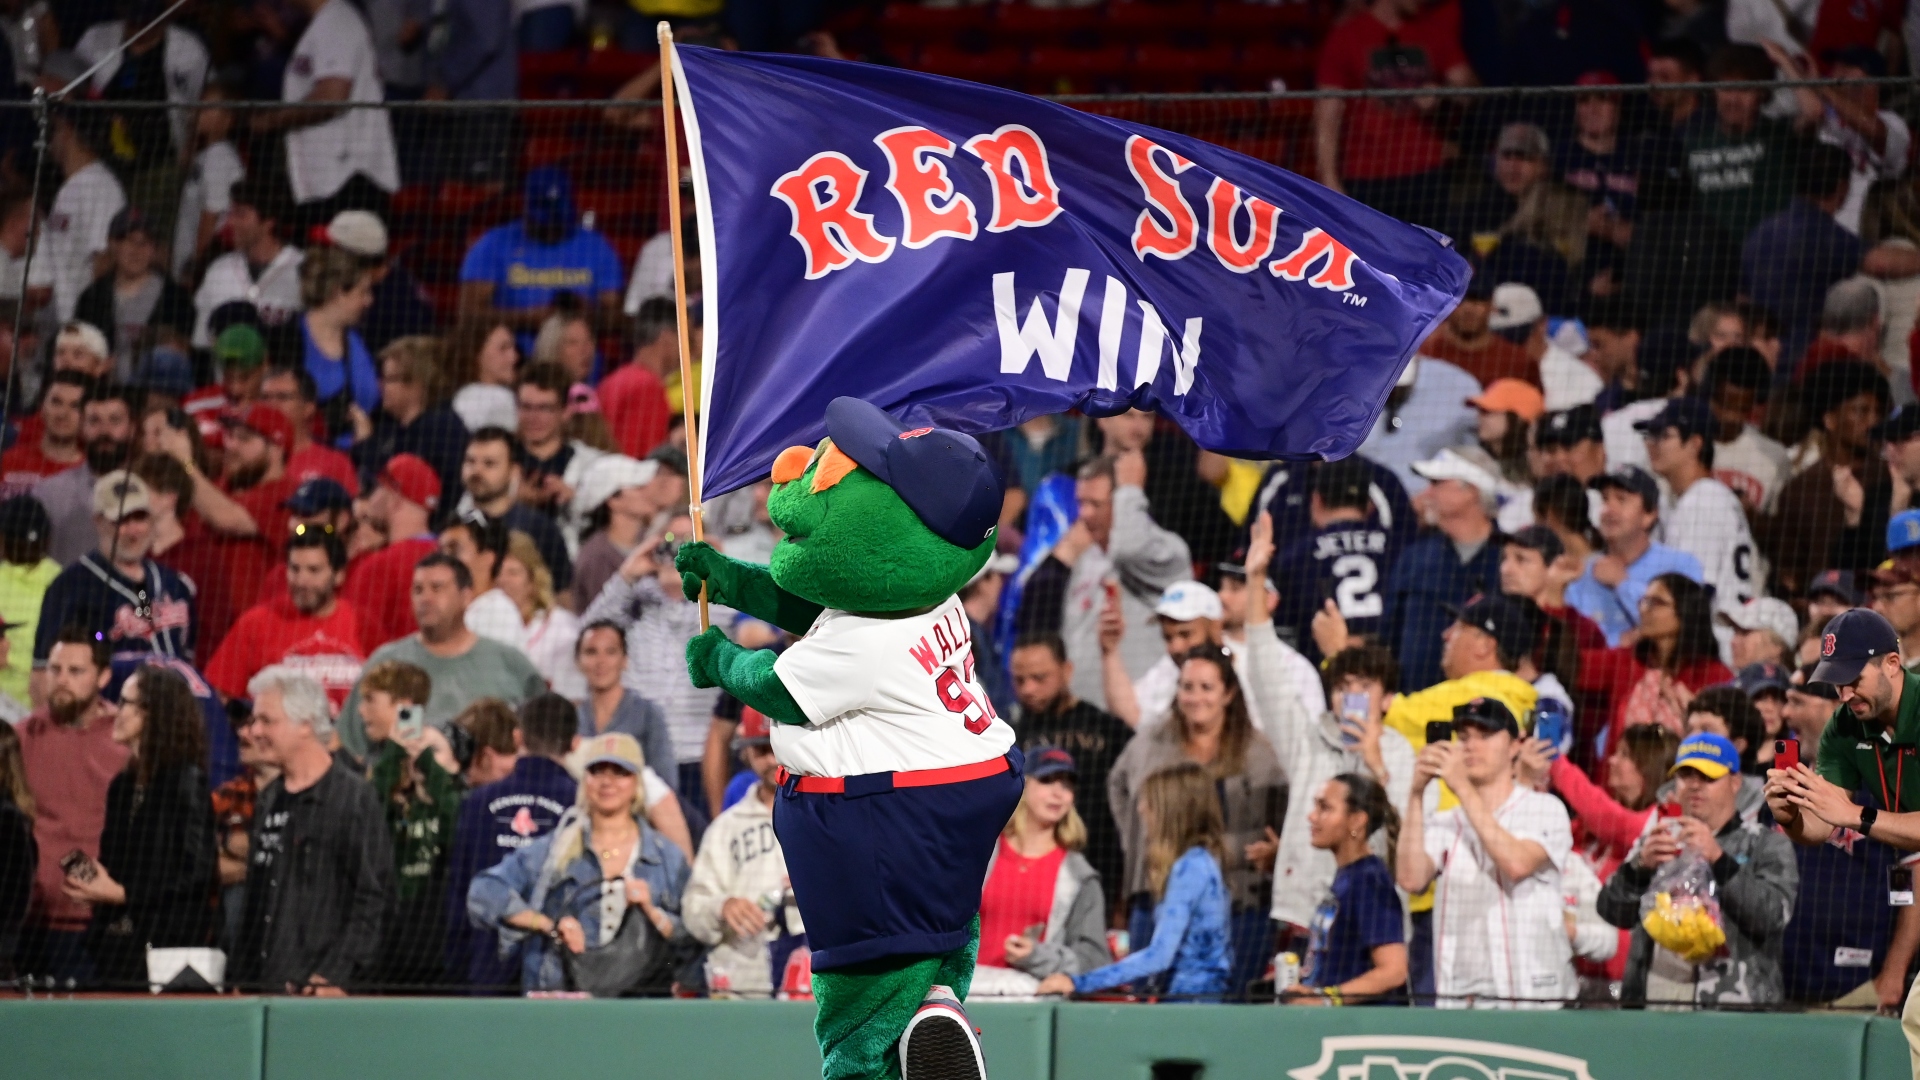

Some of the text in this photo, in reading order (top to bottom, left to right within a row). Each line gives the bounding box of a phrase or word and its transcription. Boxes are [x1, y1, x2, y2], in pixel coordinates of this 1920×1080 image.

[769, 123, 1065, 281] RED
[1341, 291, 1368, 308] TM
[991, 267, 1203, 397] WIN
[1312, 529, 1387, 560] JETER
[1332, 553, 1385, 619] 2
[1822, 632, 1837, 657] B
[728, 822, 776, 870] RED
